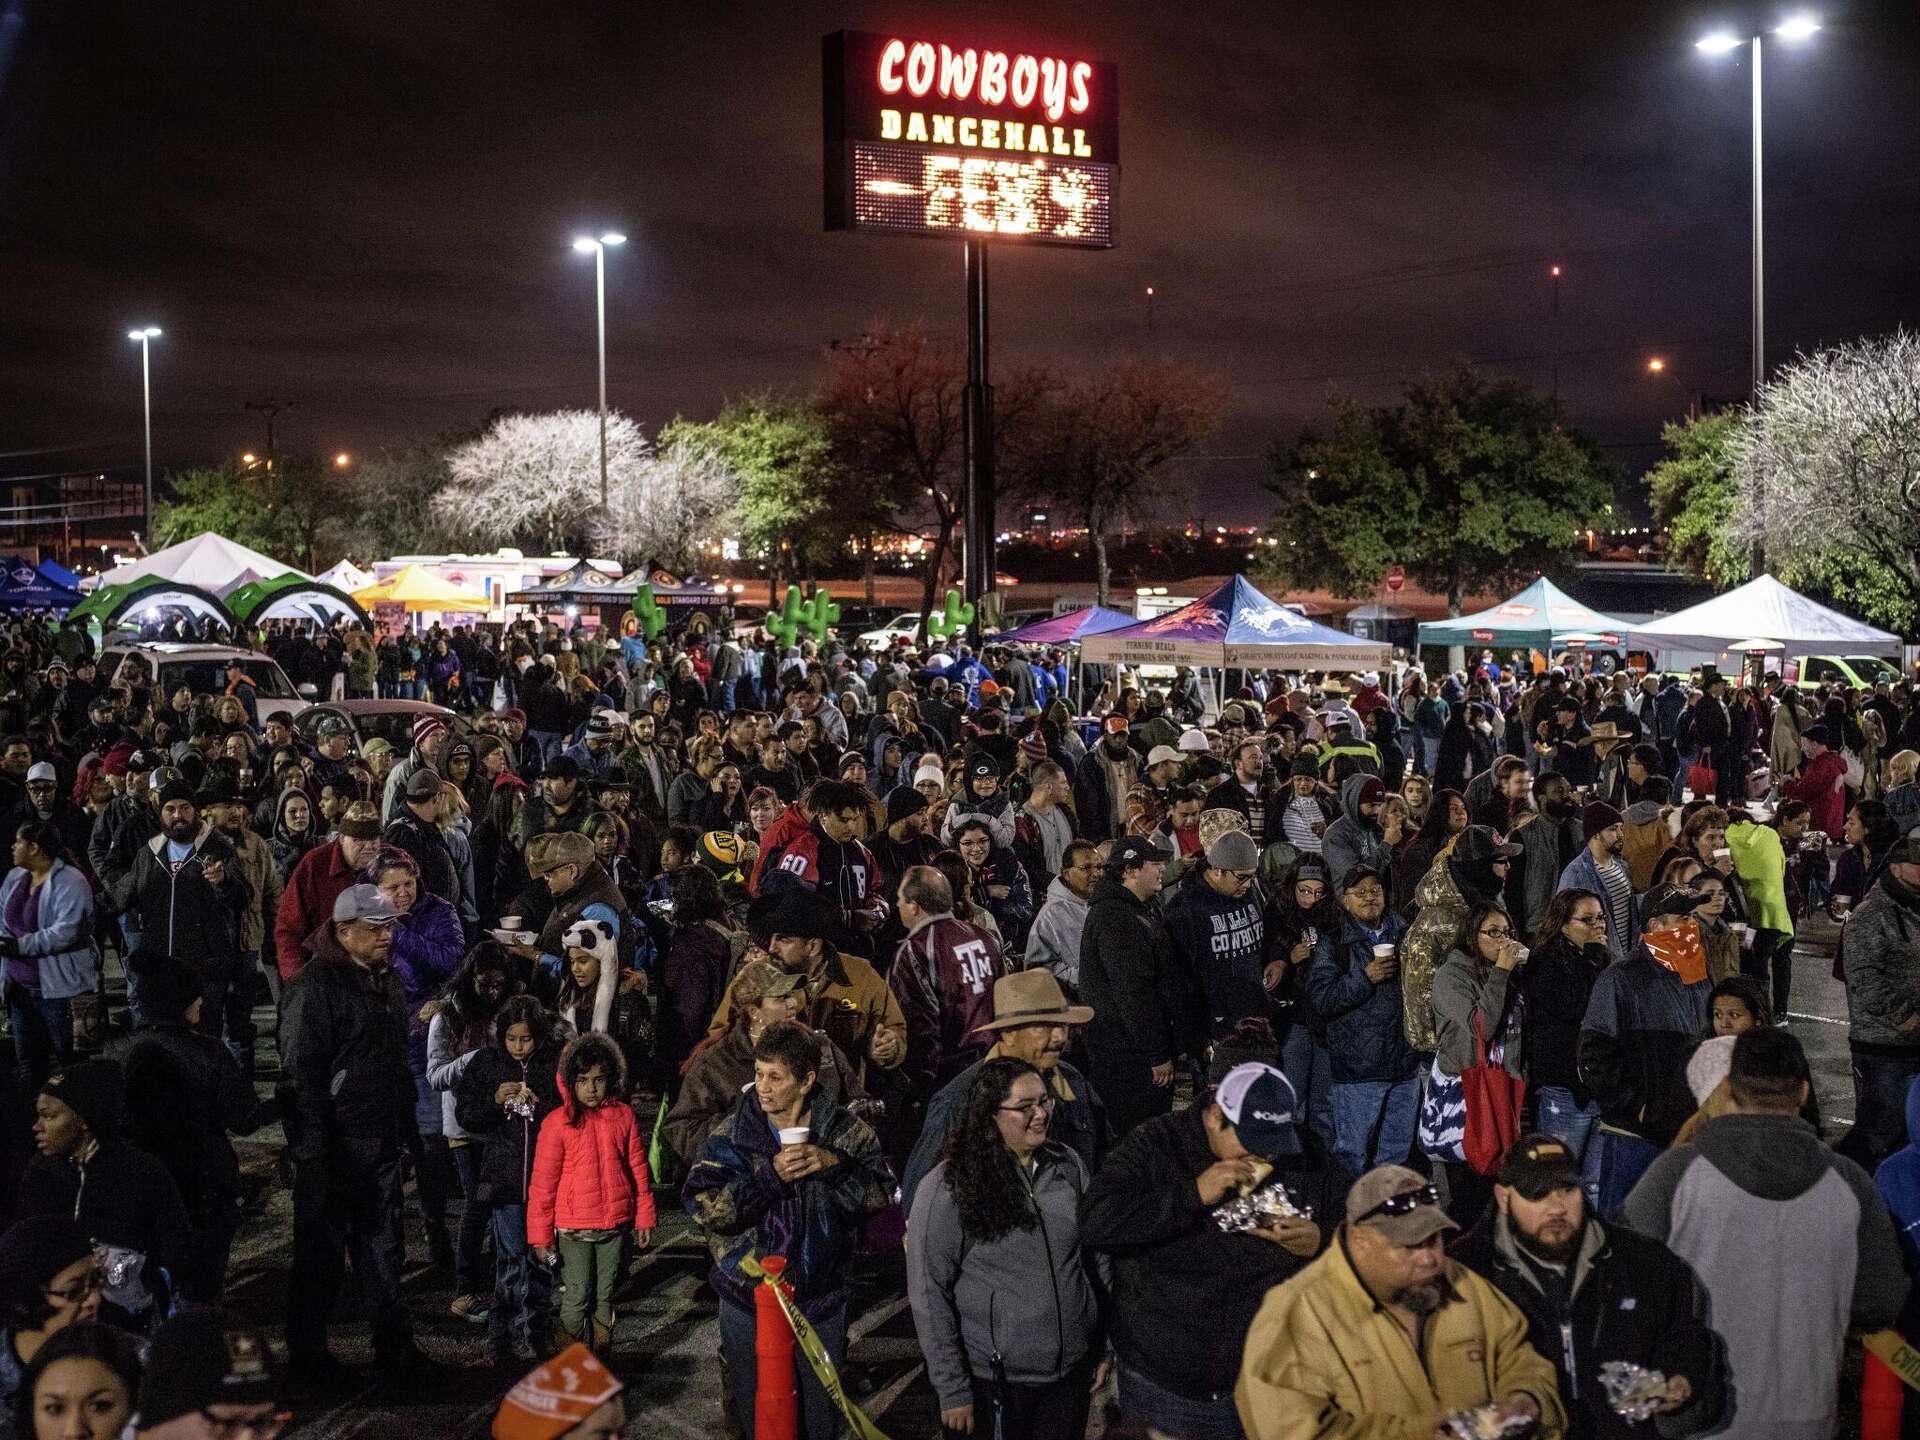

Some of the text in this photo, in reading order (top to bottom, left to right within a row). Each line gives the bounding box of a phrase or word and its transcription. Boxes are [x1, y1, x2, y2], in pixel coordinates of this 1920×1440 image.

[877, 38, 1093, 122] COWBOYS
[880, 109, 1092, 157] DANCEHALL
[780, 853, 808, 876] 60
